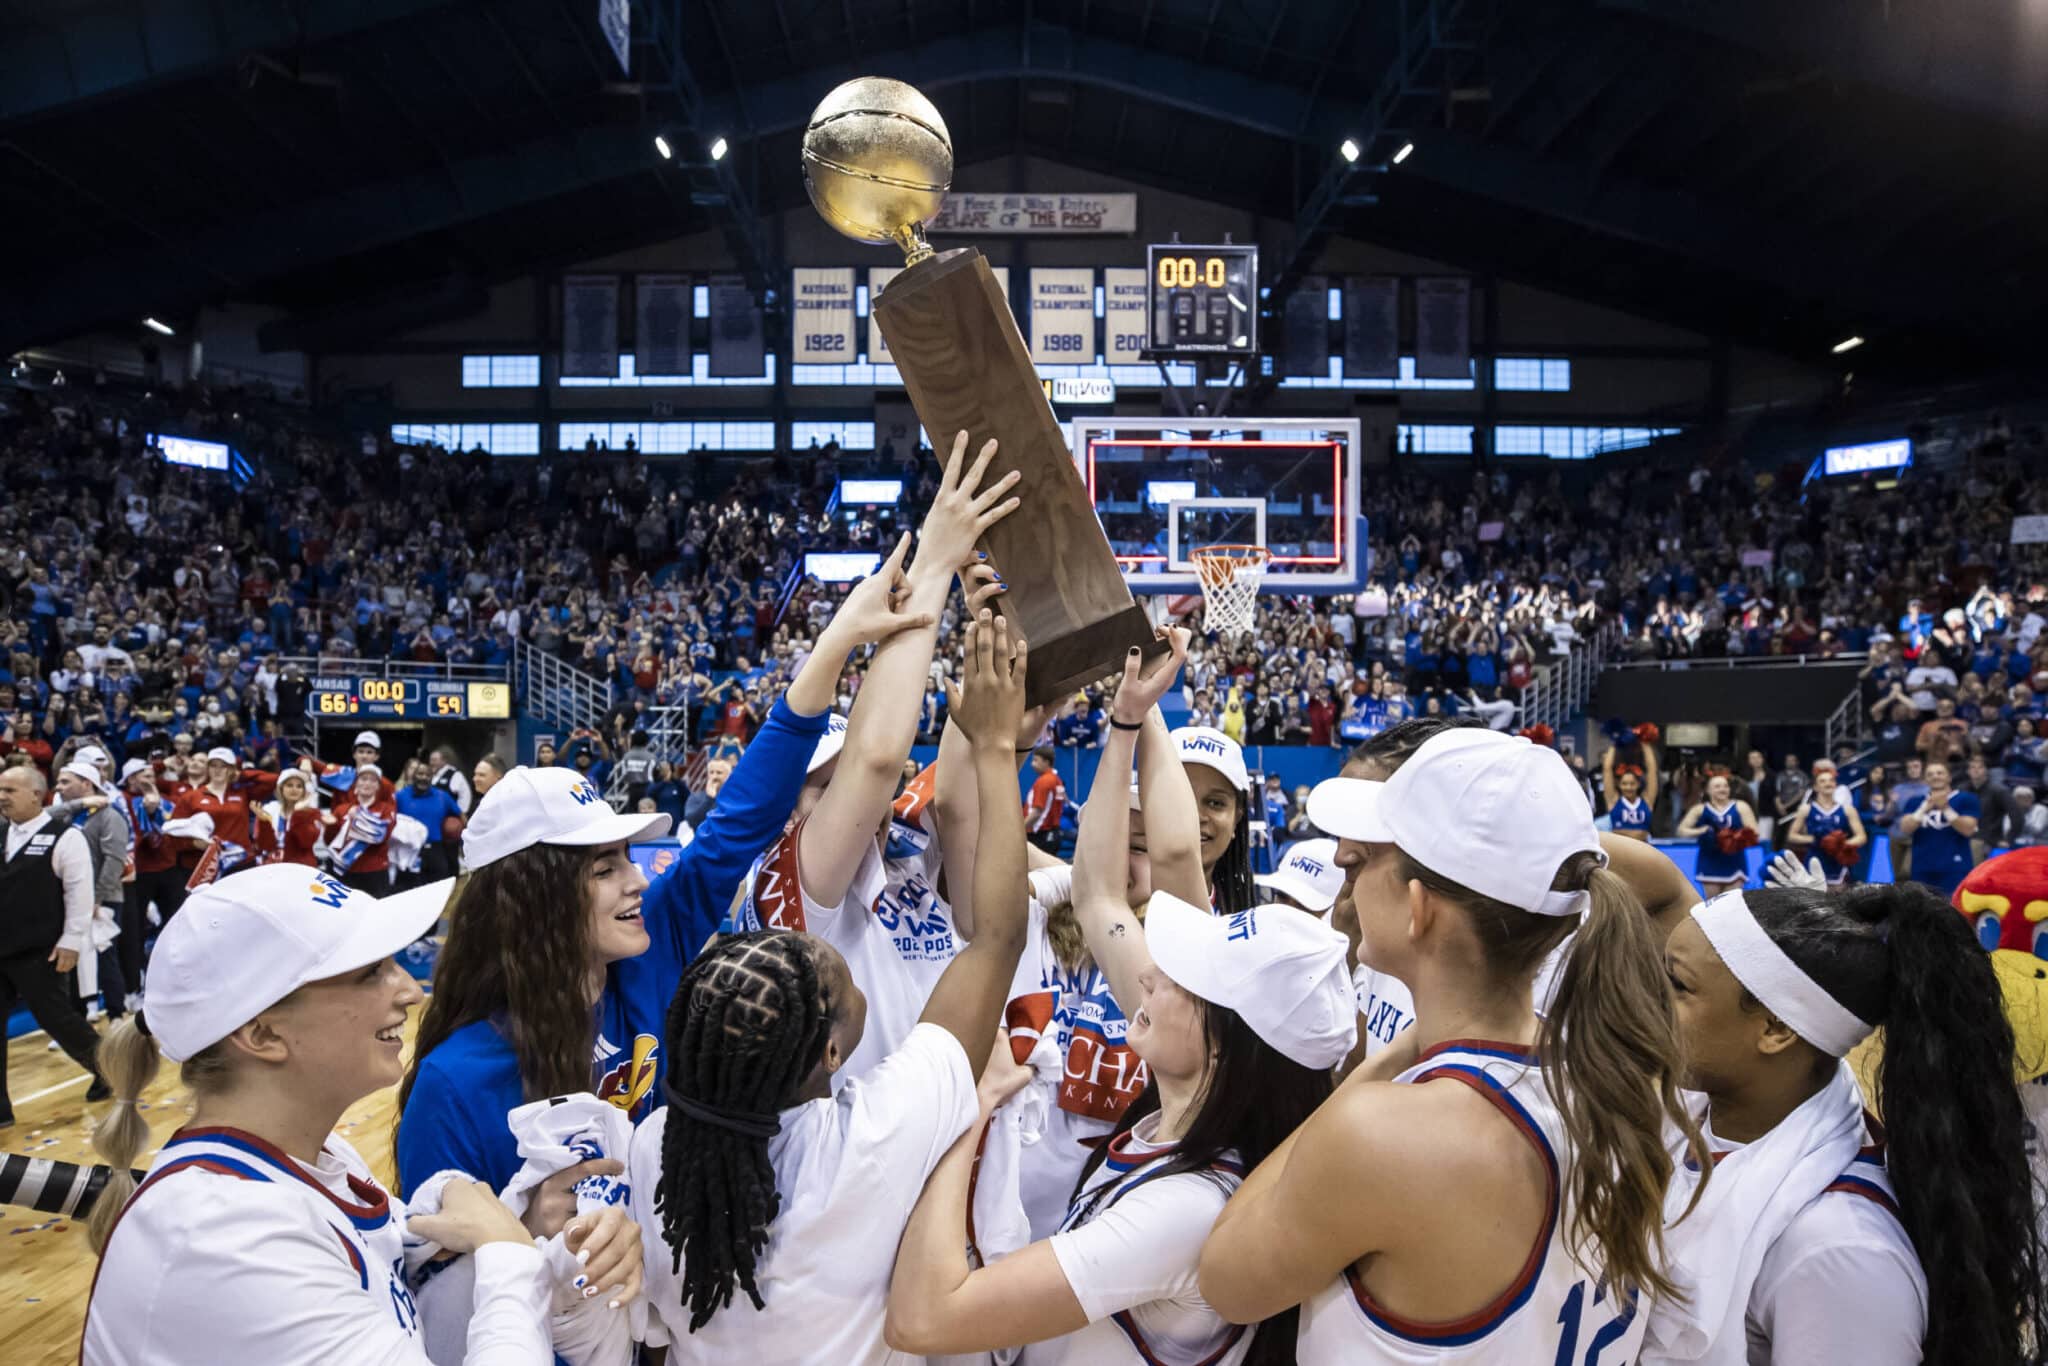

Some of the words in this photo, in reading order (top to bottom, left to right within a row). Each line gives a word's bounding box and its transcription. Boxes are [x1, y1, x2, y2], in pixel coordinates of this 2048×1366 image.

[1000, 212, 1019, 226] OF
[1159, 257, 1225, 288] 00.0
[801, 284, 849, 294] NATIONAL
[1039, 284, 1087, 294] NATIONAL
[794, 299, 855, 310] CHAMPIONS
[1033, 299, 1093, 310] CHAMPIONS
[804, 333, 845, 352] 1922
[1043, 334, 1083, 351] 1988
[1114, 334, 1147, 351] 200
[310, 679, 351, 690] KANSAS
[363, 680, 404, 701] 00.0
[427, 682, 464, 693] COLUMBIA
[320, 693, 347, 713] 66
[394, 702, 405, 716] 4
[437, 697, 462, 714] 59
[1183, 739, 1226, 757] WNIT
[1290, 857, 1324, 878] WNIT
[1227, 910, 1249, 941] NIT
